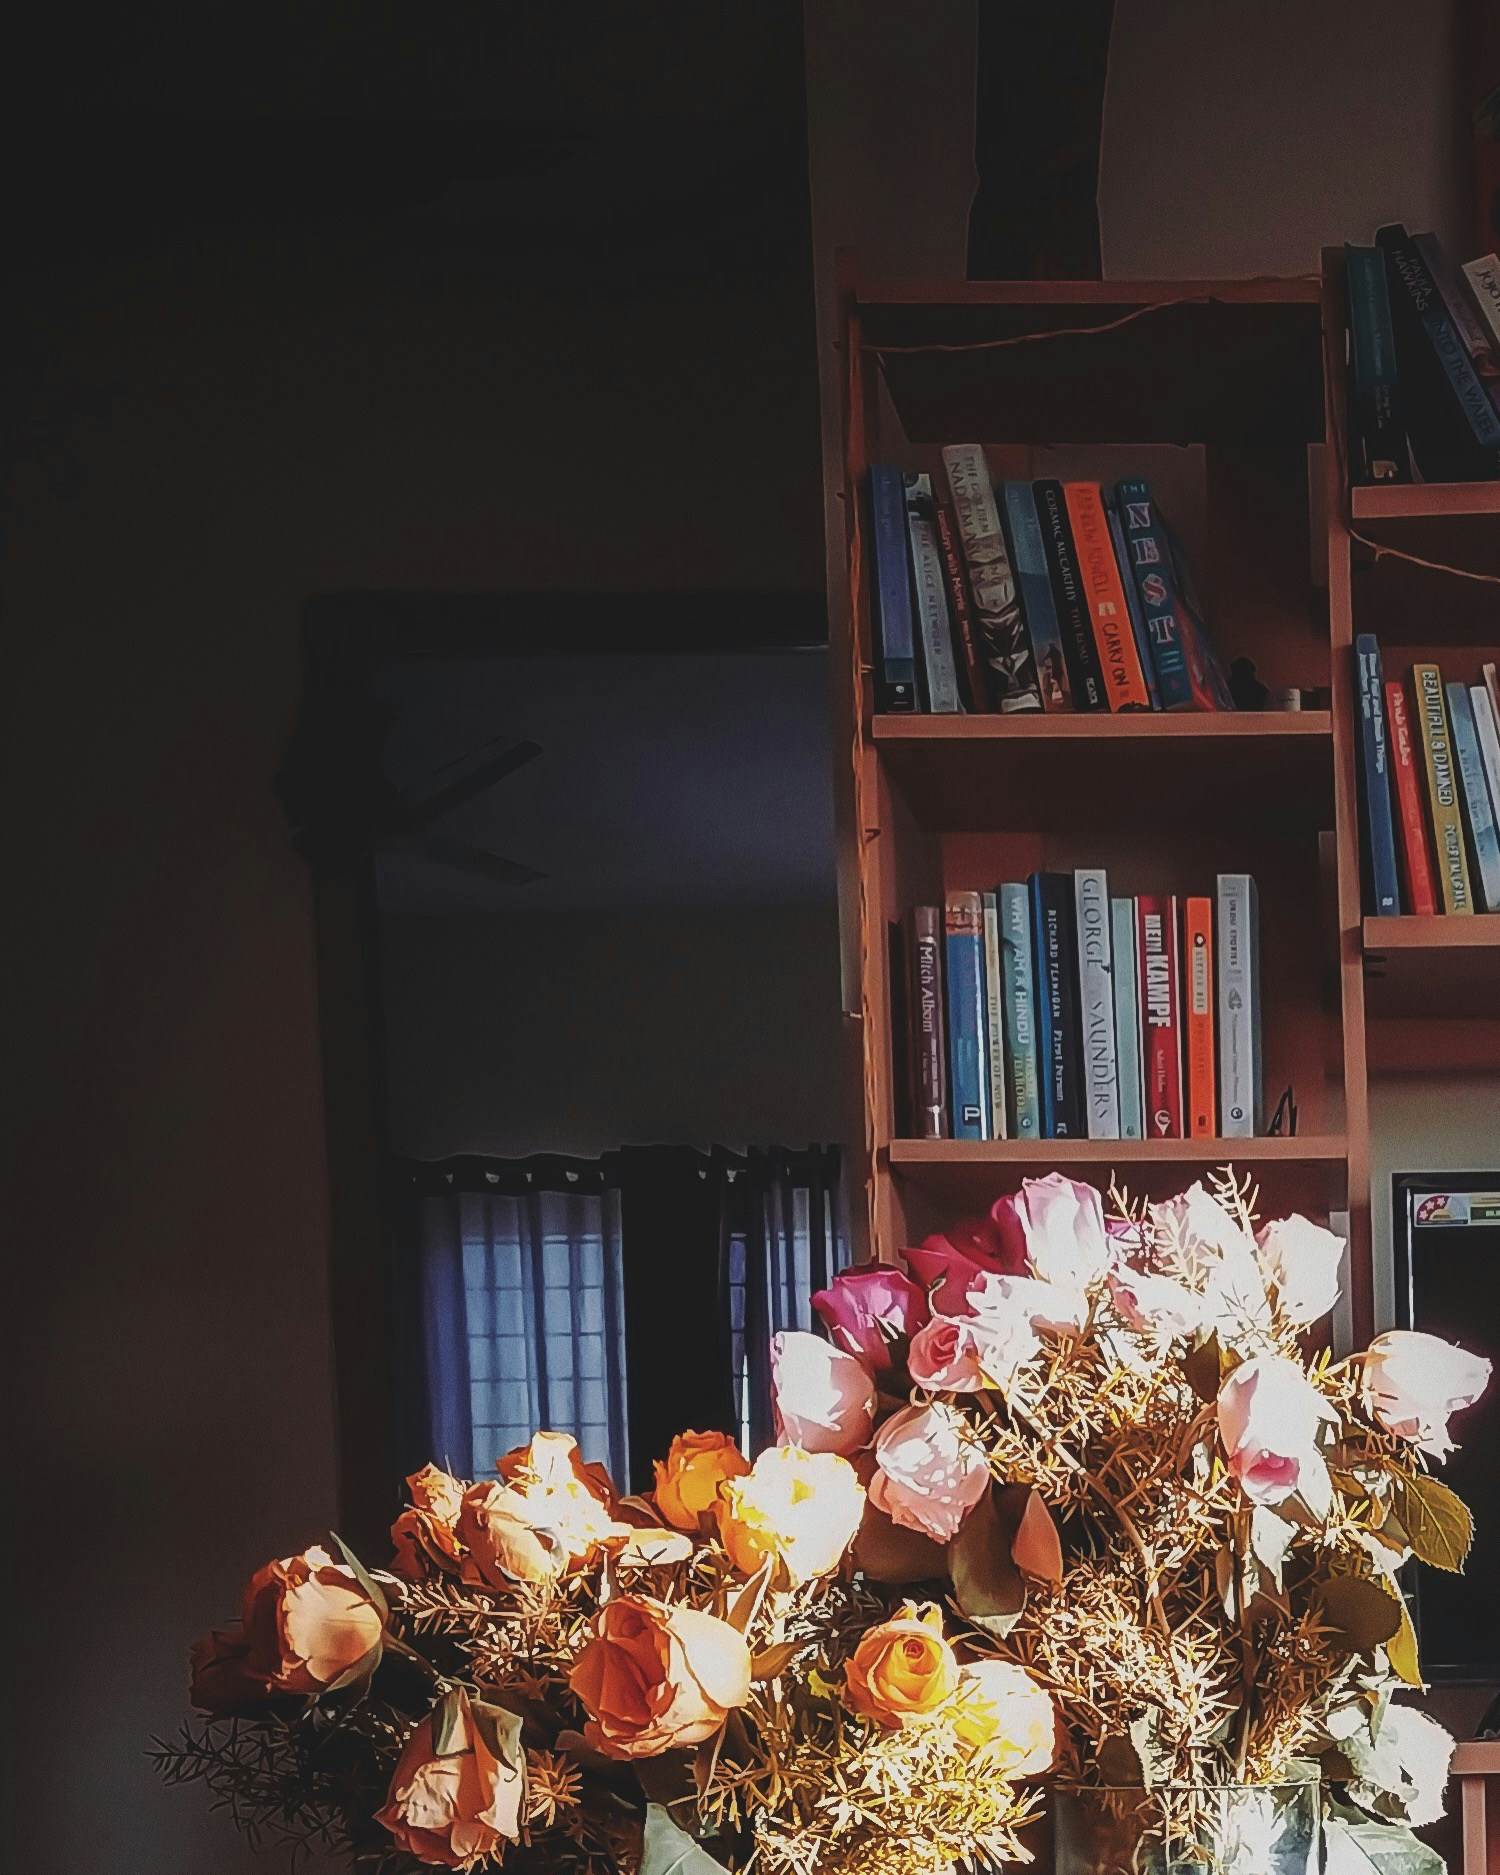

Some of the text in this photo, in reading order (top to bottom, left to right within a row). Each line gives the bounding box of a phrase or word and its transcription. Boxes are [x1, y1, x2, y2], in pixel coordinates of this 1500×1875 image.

[1390, 247, 1430, 314] HAWKINS
[1044, 489, 1064, 539] CORMAC
[1100, 621, 1130, 688] CARRY ON
[1431, 752, 1455, 808] DAMNED
[1009, 896, 1024, 935] WHY
[1047, 909, 1059, 959] RICHARD
[1012, 947, 1026, 972] AM
[1013, 975, 1026, 988] A
[1143, 914, 1171, 1028] MEIN KAMPF
[922, 989, 936, 1032] Albom
[1050, 962, 1061, 1019] FLANAGAN
[1081, 877, 1113, 1119] GEORGE SAUNDERS
[1013, 991, 1029, 1045] HINDU
